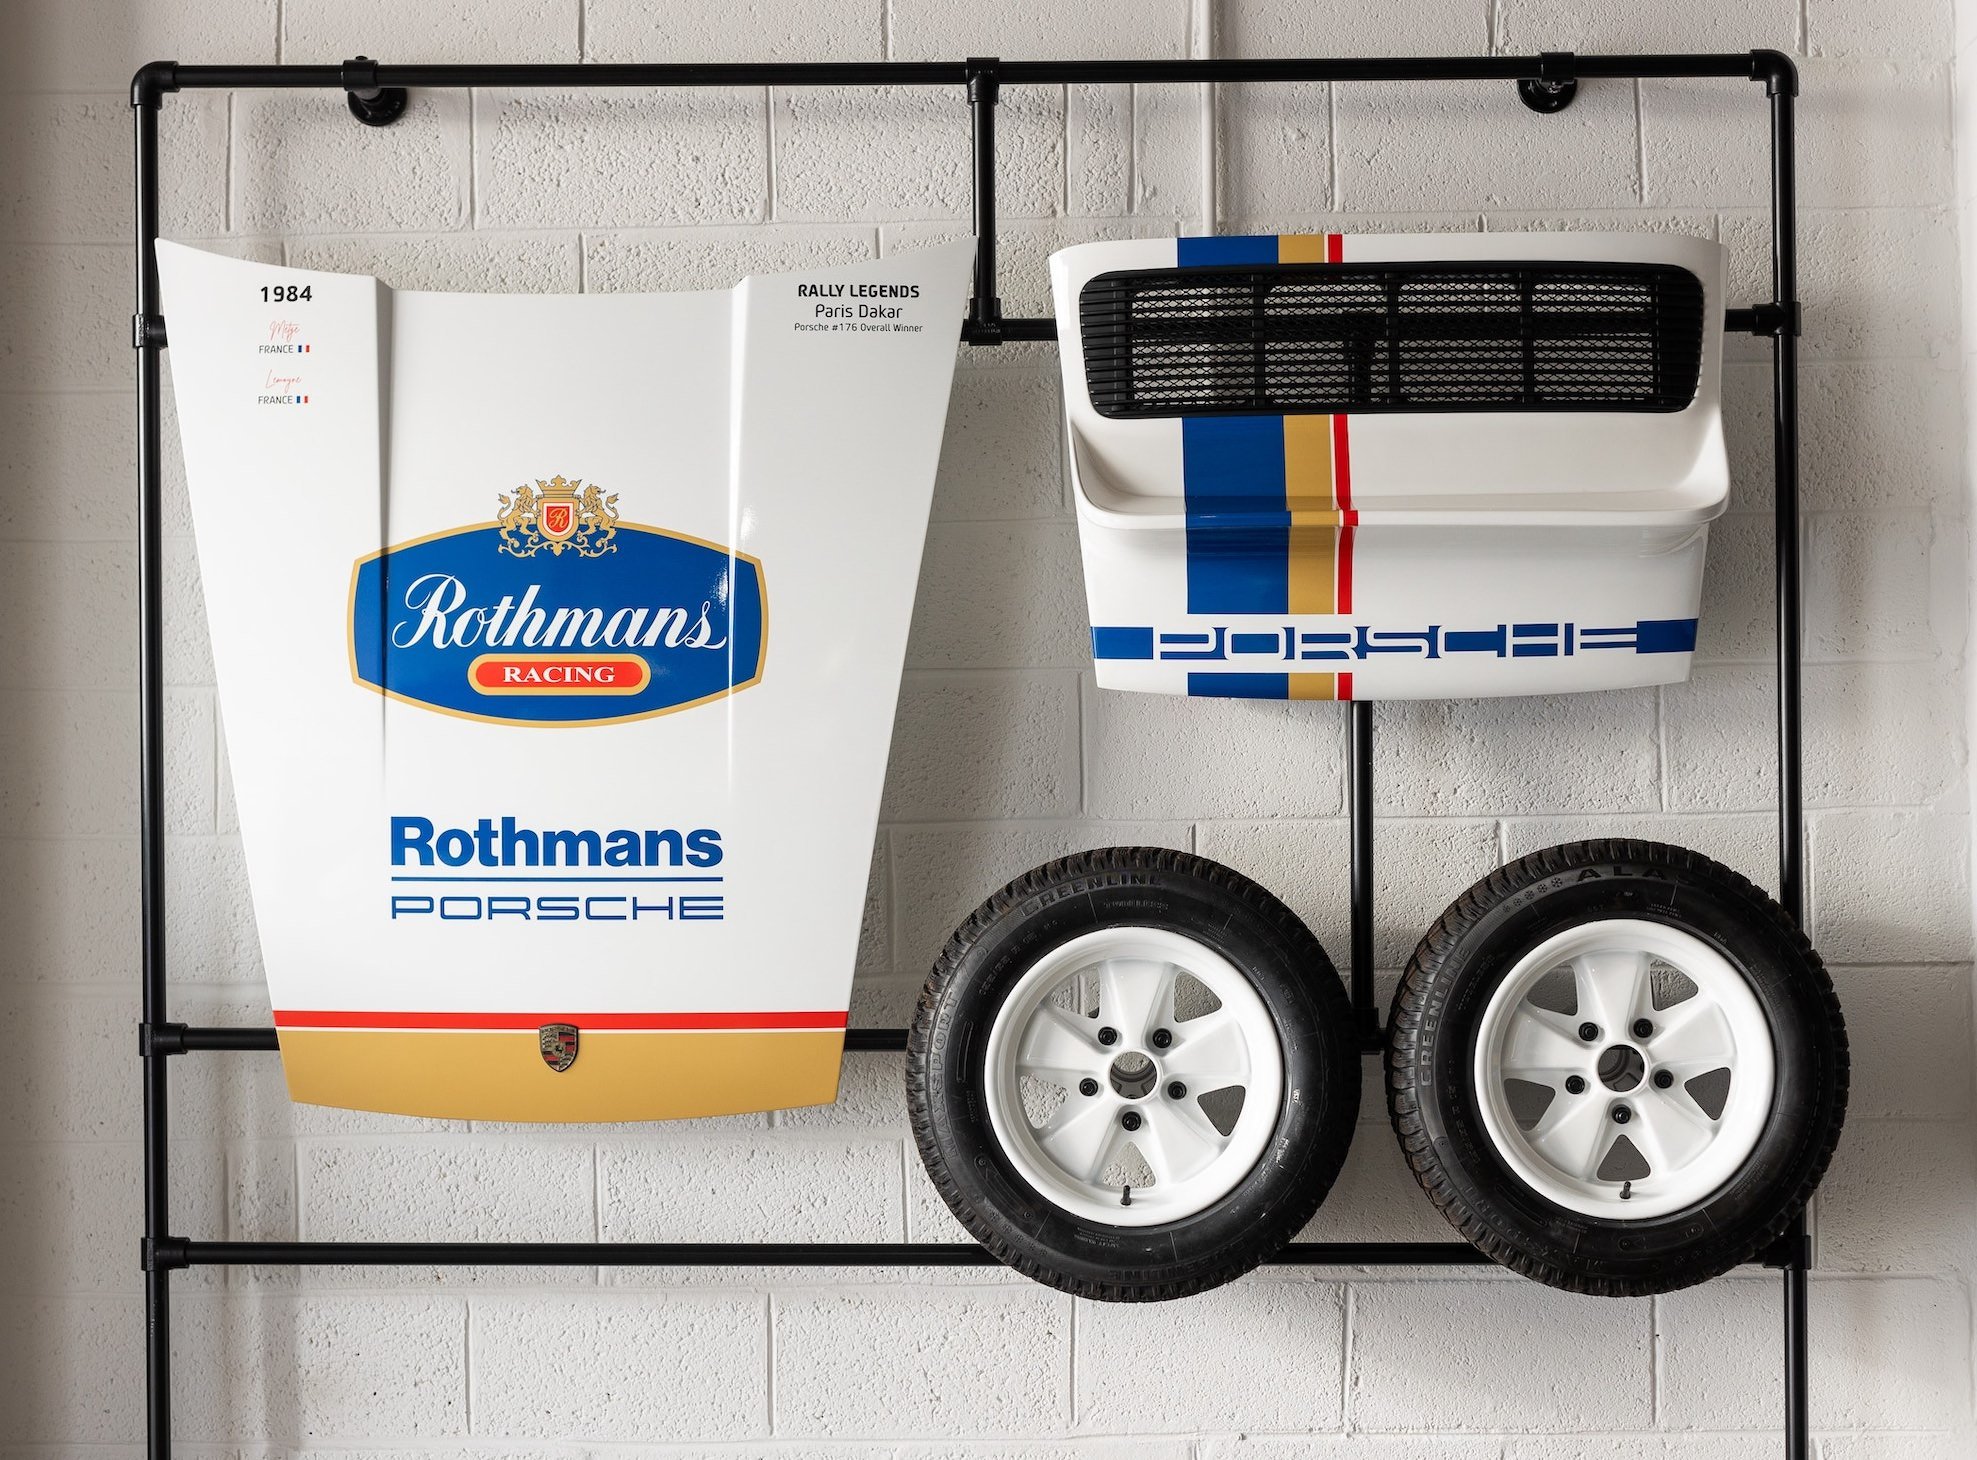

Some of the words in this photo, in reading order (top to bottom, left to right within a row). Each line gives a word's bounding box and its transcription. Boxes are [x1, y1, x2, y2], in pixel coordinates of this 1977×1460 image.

[260, 285, 312, 303] 1984
[798, 284, 845, 297] RALLY
[850, 284, 920, 298] LEGENDS
[815, 303, 853, 318] Paris
[858, 304, 903, 319] Dakar
[794, 322, 829, 332] Porsche
[832, 323, 858, 332] #176
[860, 323, 891, 332] Overall
[893, 323, 923, 333] Winner
[258, 344, 294, 354] FRANCE
[258, 395, 293, 405] FRANCE
[549, 508, 568, 528] R
[391, 573, 727, 650] Rothmans
[1153, 620, 1637, 660] PORSCHE
[503, 665, 615, 684] RACING
[391, 816, 724, 868] Rothmans
[391, 896, 724, 920] PORSCHE
[1420, 946, 1470, 1087] GREENLINE
[930, 991, 959, 1160] MAXSPORT
